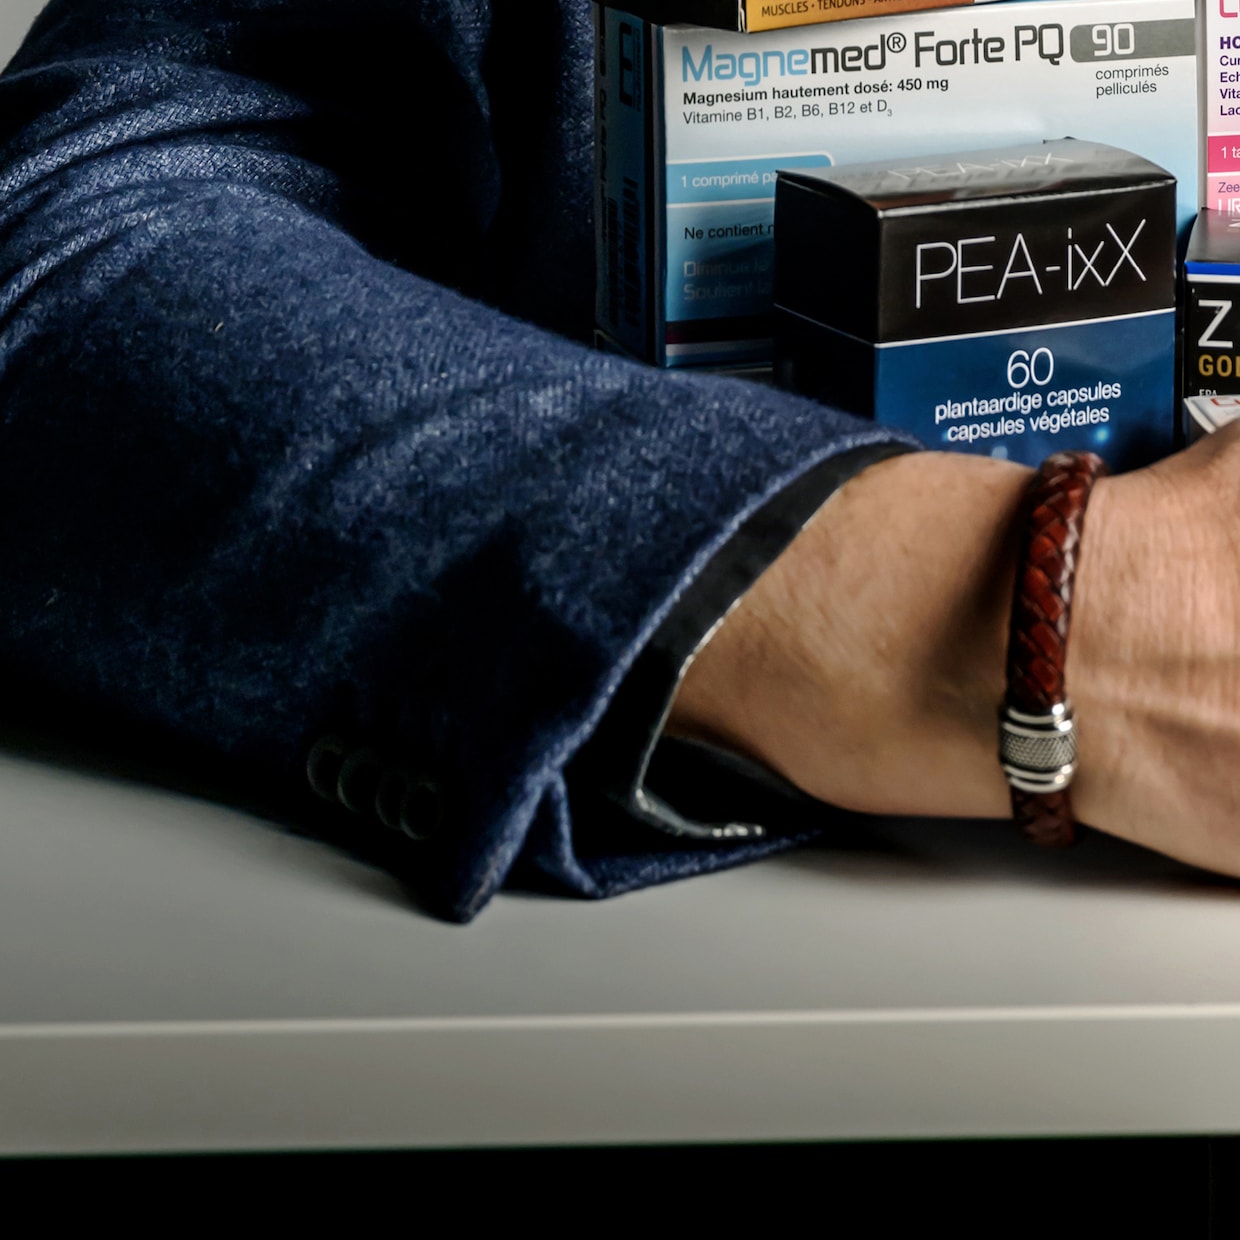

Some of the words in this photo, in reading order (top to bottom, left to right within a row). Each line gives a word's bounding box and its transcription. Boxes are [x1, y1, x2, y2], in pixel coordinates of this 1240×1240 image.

[761, 1, 809, 17] MUSCLES
[914, 28, 1005, 68] Forte
[1014, 23, 1064, 65] PQ
[1092, 23, 1135, 57] 90
[1095, 63, 1169, 81] comprimés
[683, 89, 768, 106] Magnesium
[772, 84, 850, 101] hautement
[855, 80, 893, 94] dosé:
[897, 78, 922, 92] 450
[926, 79, 949, 93] mg
[1096, 81, 1157, 99] pelliculés
[683, 110, 743, 125] Vitamine
[747, 108, 770, 122] B1,
[774, 106, 797, 120] B2,
[802, 103, 824, 118] B6,
[828, 101, 856, 115] B12
[859, 100, 873, 113] et
[1221, 147, 1227, 158] 1
[681, 175, 687, 188] 1
[692, 171, 759, 189] comprimé
[684, 226, 704, 240] Ne
[707, 223, 764, 239] contient
[915, 218, 1147, 309] PEA-ixX
[1006, 347, 1055, 389] 60
[934, 392, 1043, 424] plantaardige
[1046, 381, 1122, 413] capsules
[947, 411, 1026, 443] capsules
[1030, 405, 1110, 433] végétales
